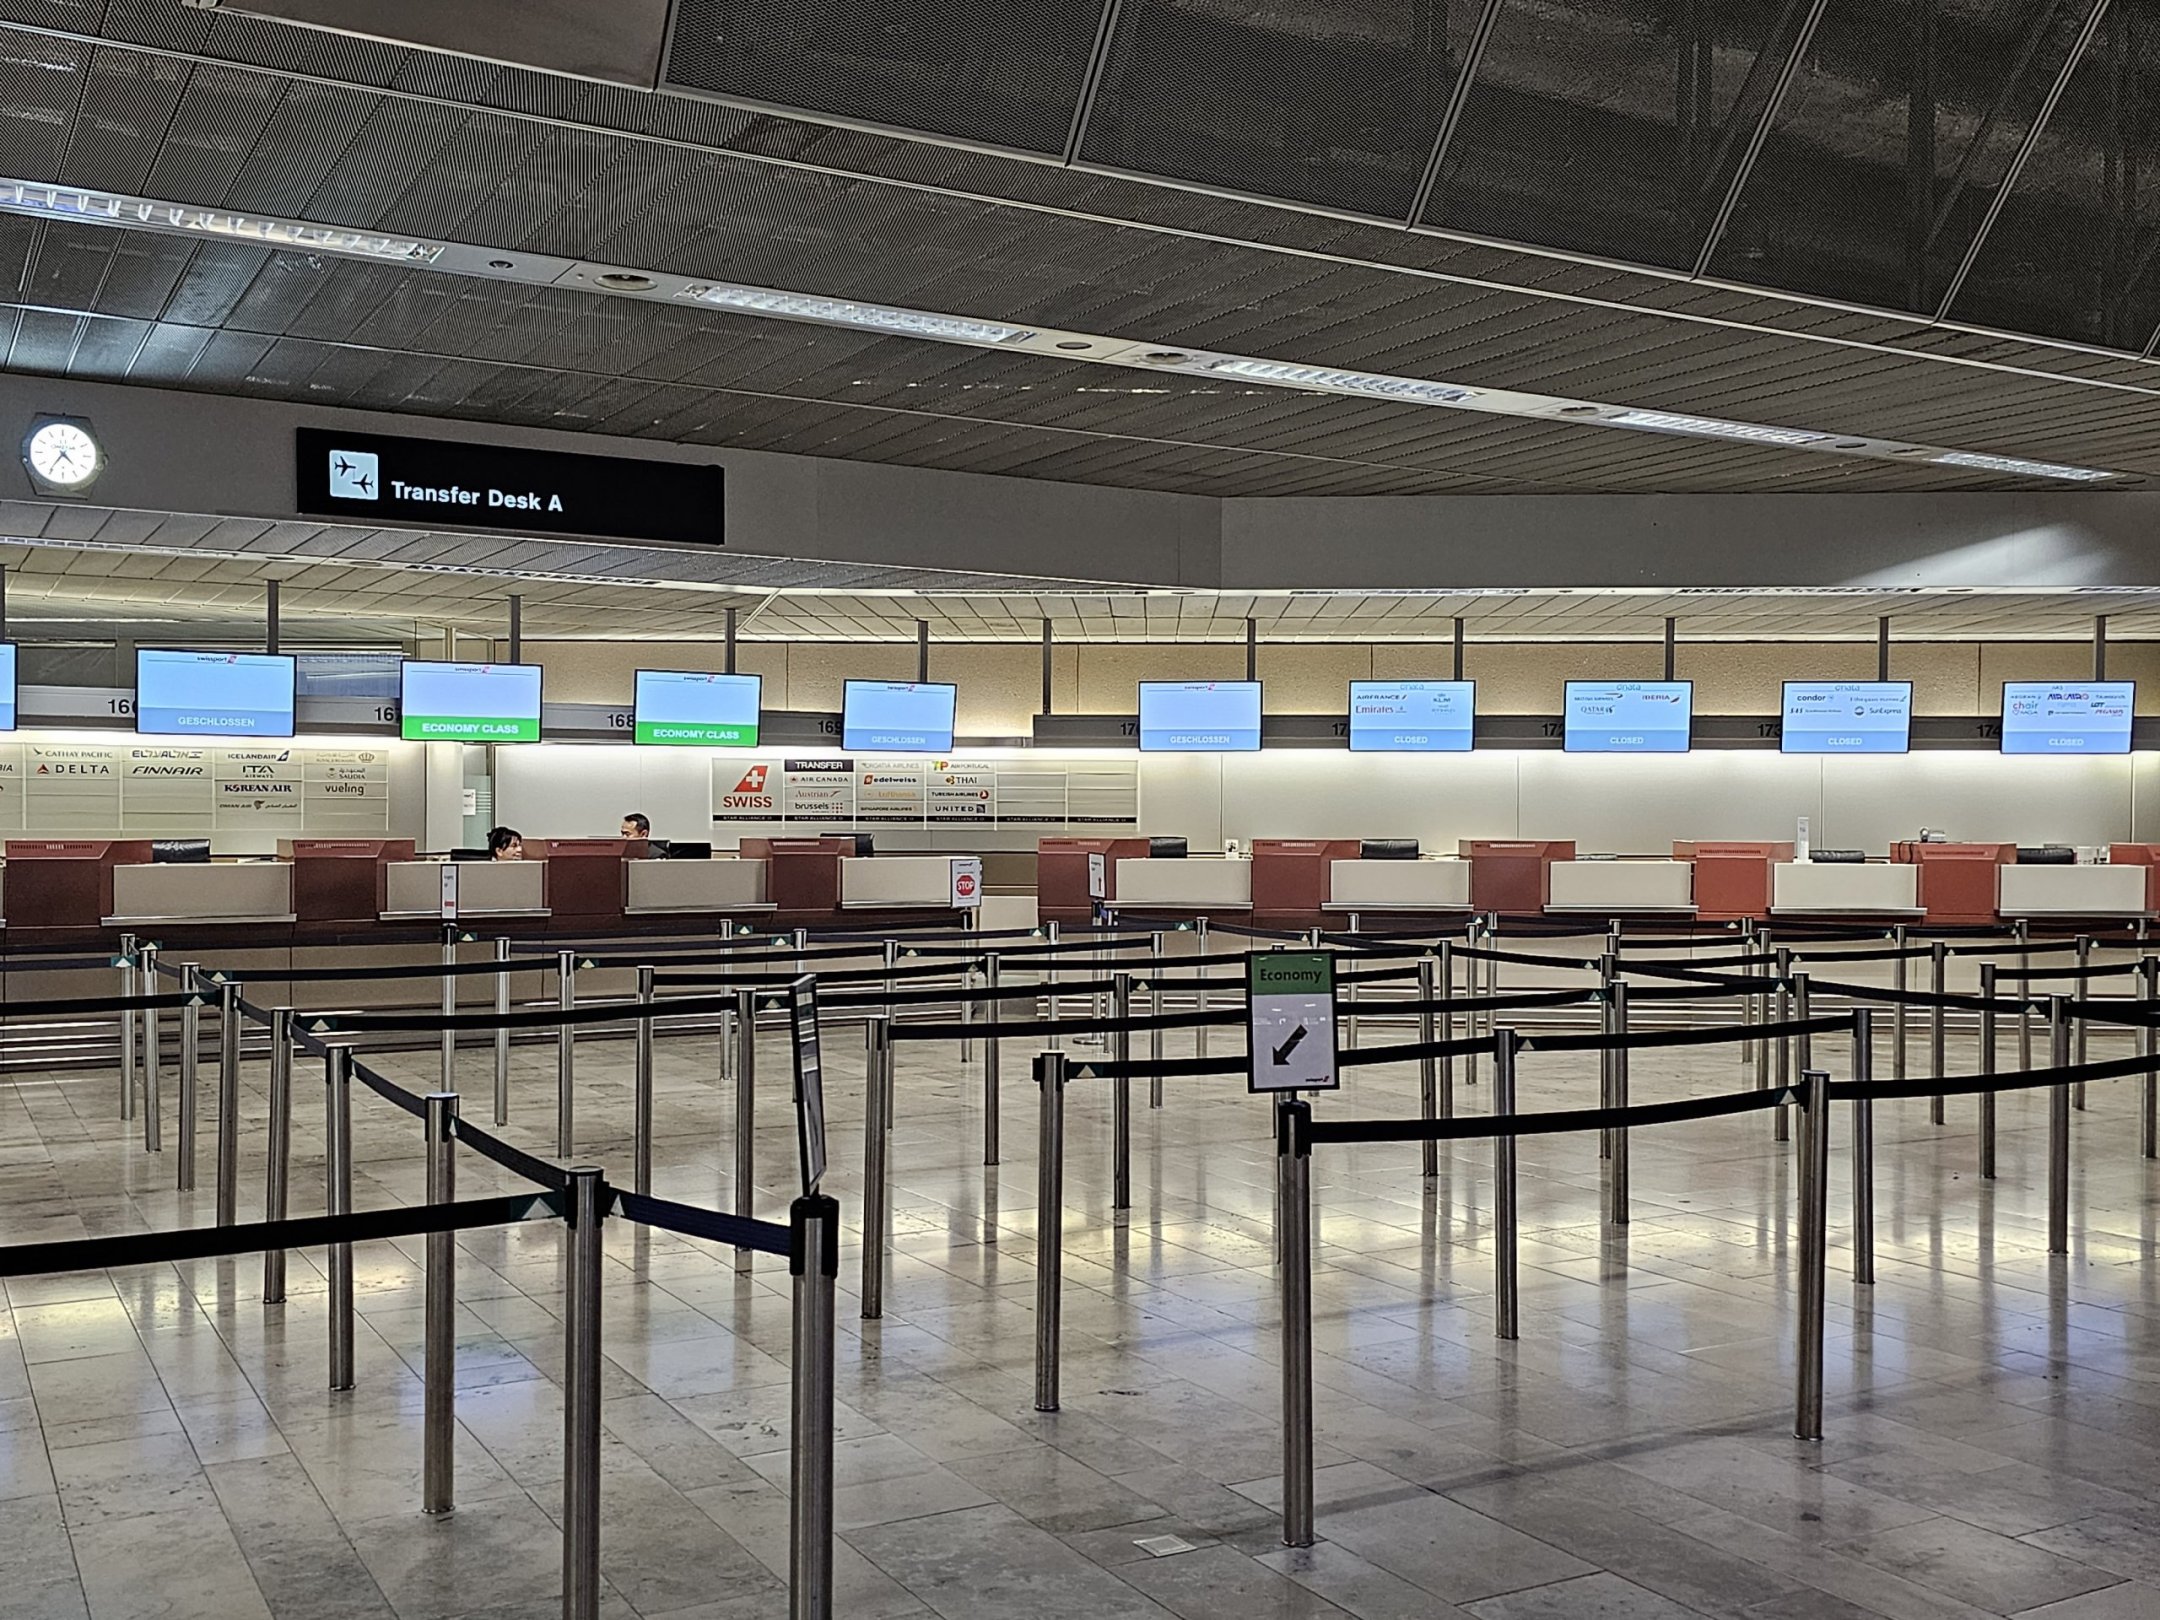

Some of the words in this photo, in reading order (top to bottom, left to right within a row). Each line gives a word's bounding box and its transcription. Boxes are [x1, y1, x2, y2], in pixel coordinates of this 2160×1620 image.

[391, 480, 480, 505] Transfer
[488, 489, 541, 511] Desk
[548, 494, 563, 512] A
[1796, 694, 1826, 702] condor
[1355, 705, 1394, 714] Emirates
[2012, 700, 2039, 710] chair
[178, 715, 255, 728] GESCHLOSSEN
[422, 723, 480, 734] ECONOMY
[481, 724, 519, 734] CLASS
[1120, 723, 1138, 736] 17
[653, 728, 705, 739] ECONOMY
[706, 730, 740, 740] CLASS
[871, 735, 926, 745] GESCHLOSSEN
[1169, 735, 1230, 744] GESCHLOSSEN
[1394, 735, 1428, 744] CLOSED
[1609, 736, 1644, 745] CLOSED
[1827, 737, 1863, 745] CLOSED
[2048, 738, 2084, 746] CLOSED
[45, 750, 80, 758] CATHAY
[81, 751, 113, 759] PACIFIC
[227, 753, 276, 761] ICELANDAIR
[55, 764, 110, 774] DELTA
[242, 765, 275, 774] ITA
[795, 761, 844, 770] TRANSFER
[132, 766, 204, 775] FINNAIR
[873, 775, 917, 783] edelweiss
[956, 776, 978, 784] THAI
[224, 783, 269, 793] KOREAN
[271, 784, 292, 793] AIR
[325, 782, 365, 796] vueling
[795, 790, 829, 799] Austrian
[723, 795, 773, 809] SWISS
[795, 802, 829, 810] brussels
[957, 880, 975, 891] STOP
[1260, 968, 1323, 984] Economy
